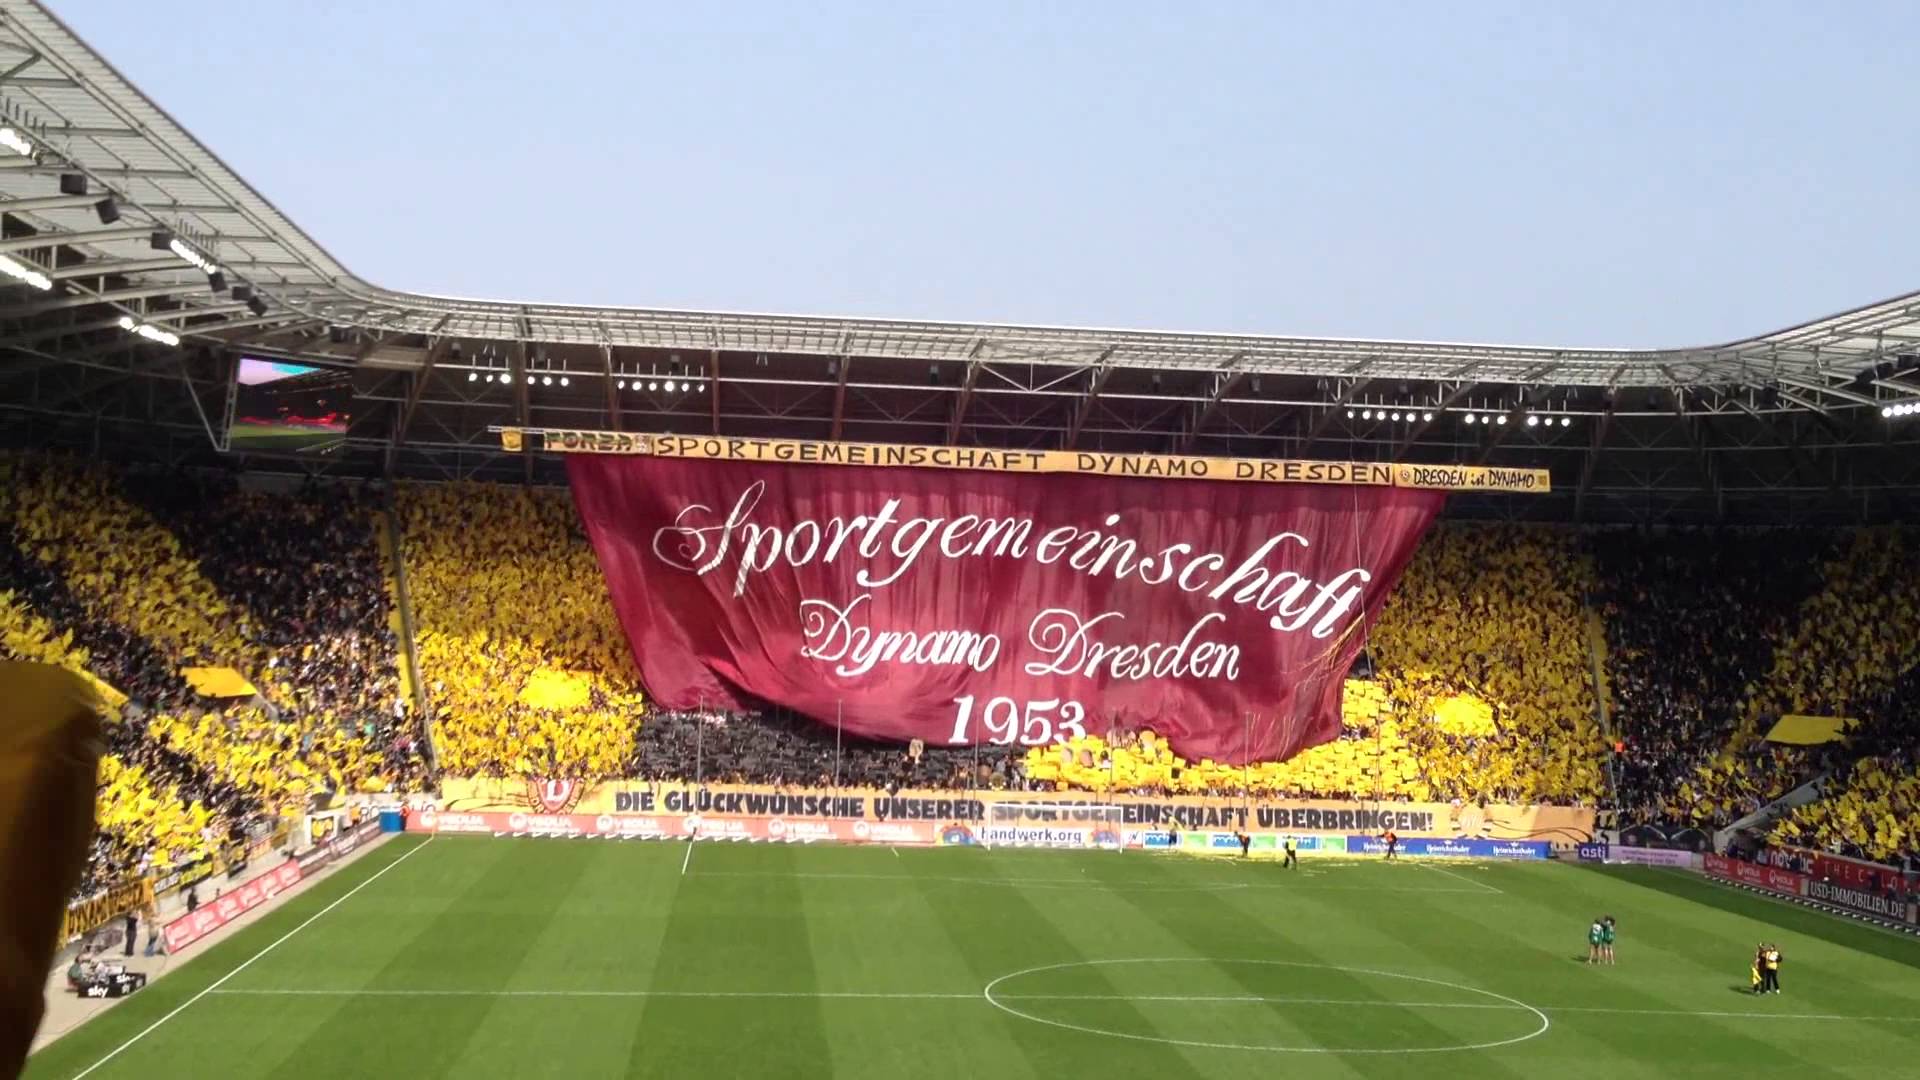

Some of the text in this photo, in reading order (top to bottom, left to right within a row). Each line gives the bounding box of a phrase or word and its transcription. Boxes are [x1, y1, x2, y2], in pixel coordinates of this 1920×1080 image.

[545, 432, 633, 451] FORZA
[658, 436, 1391, 485] SPORTGEMEINSCHAFT DYNAMO DRESDEN
[1413, 467, 1535, 488] DRESDEN ist DYNAMO
[652, 480, 1370, 639] Sportgemeinschaft
[800, 594, 1241, 681] Dynamo Dresden
[948, 694, 1087, 747] 1953
[615, 791, 655, 812] DIE
[664, 788, 865, 818] GLÜCKWÜNSCHE
[874, 797, 985, 821] UNSERER
[993, 800, 1249, 827] SPORTGEMEINSCHAFT
[1257, 804, 1433, 832] ÜBERBRINGEN!
[981, 826, 1082, 843] handwerk.org
[1580, 846, 1606, 859] asti
[1810, 880, 1906, 918] USD-IMMOBILIEN.DE
[87, 985, 109, 999] sky
